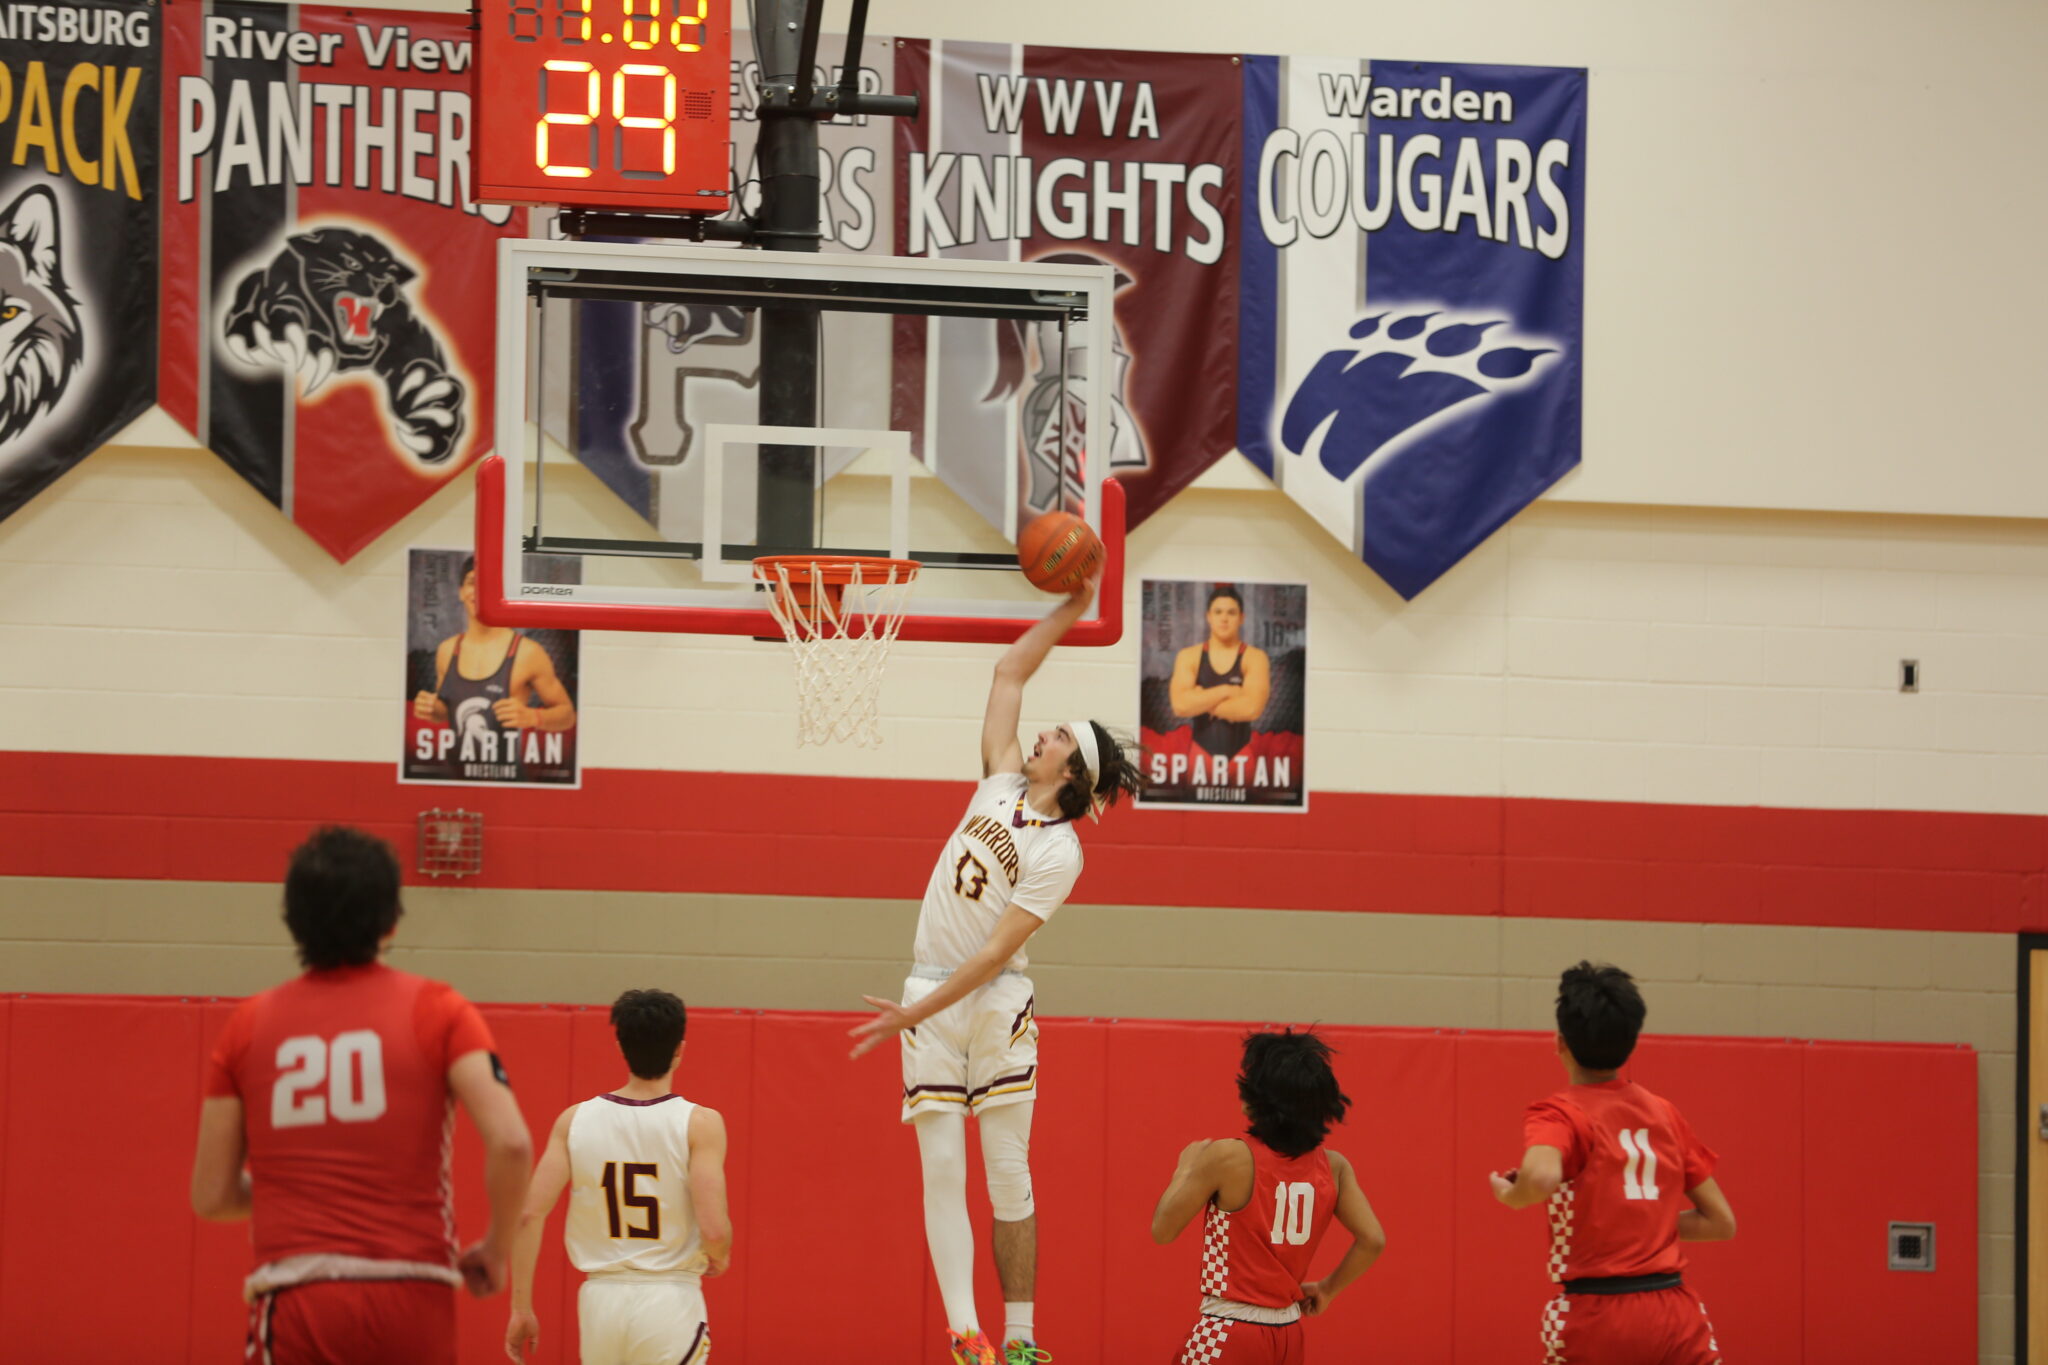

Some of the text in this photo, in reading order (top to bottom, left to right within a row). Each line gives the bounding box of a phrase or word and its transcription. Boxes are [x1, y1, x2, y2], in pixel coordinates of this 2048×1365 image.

[205, 16, 342, 64] River
[536, 60, 677, 178] 29
[976, 73, 1160, 139] WWVA
[1318, 73, 1514, 122] Warden
[178, 76, 512, 225] PANTHER
[908, 152, 1226, 264] KNIGHTS
[1258, 127, 1569, 259] COUGARS
[416, 728, 562, 764] SPARTAN
[1151, 753, 1290, 787] SPARTAN
[954, 849, 988, 901] 13
[960, 815, 1020, 888] WARRIORS
[271, 1028, 387, 1129] 20
[601, 1161, 660, 1239] 15
[1618, 1128, 1659, 1200] 11
[1270, 1181, 1314, 1245] 10
